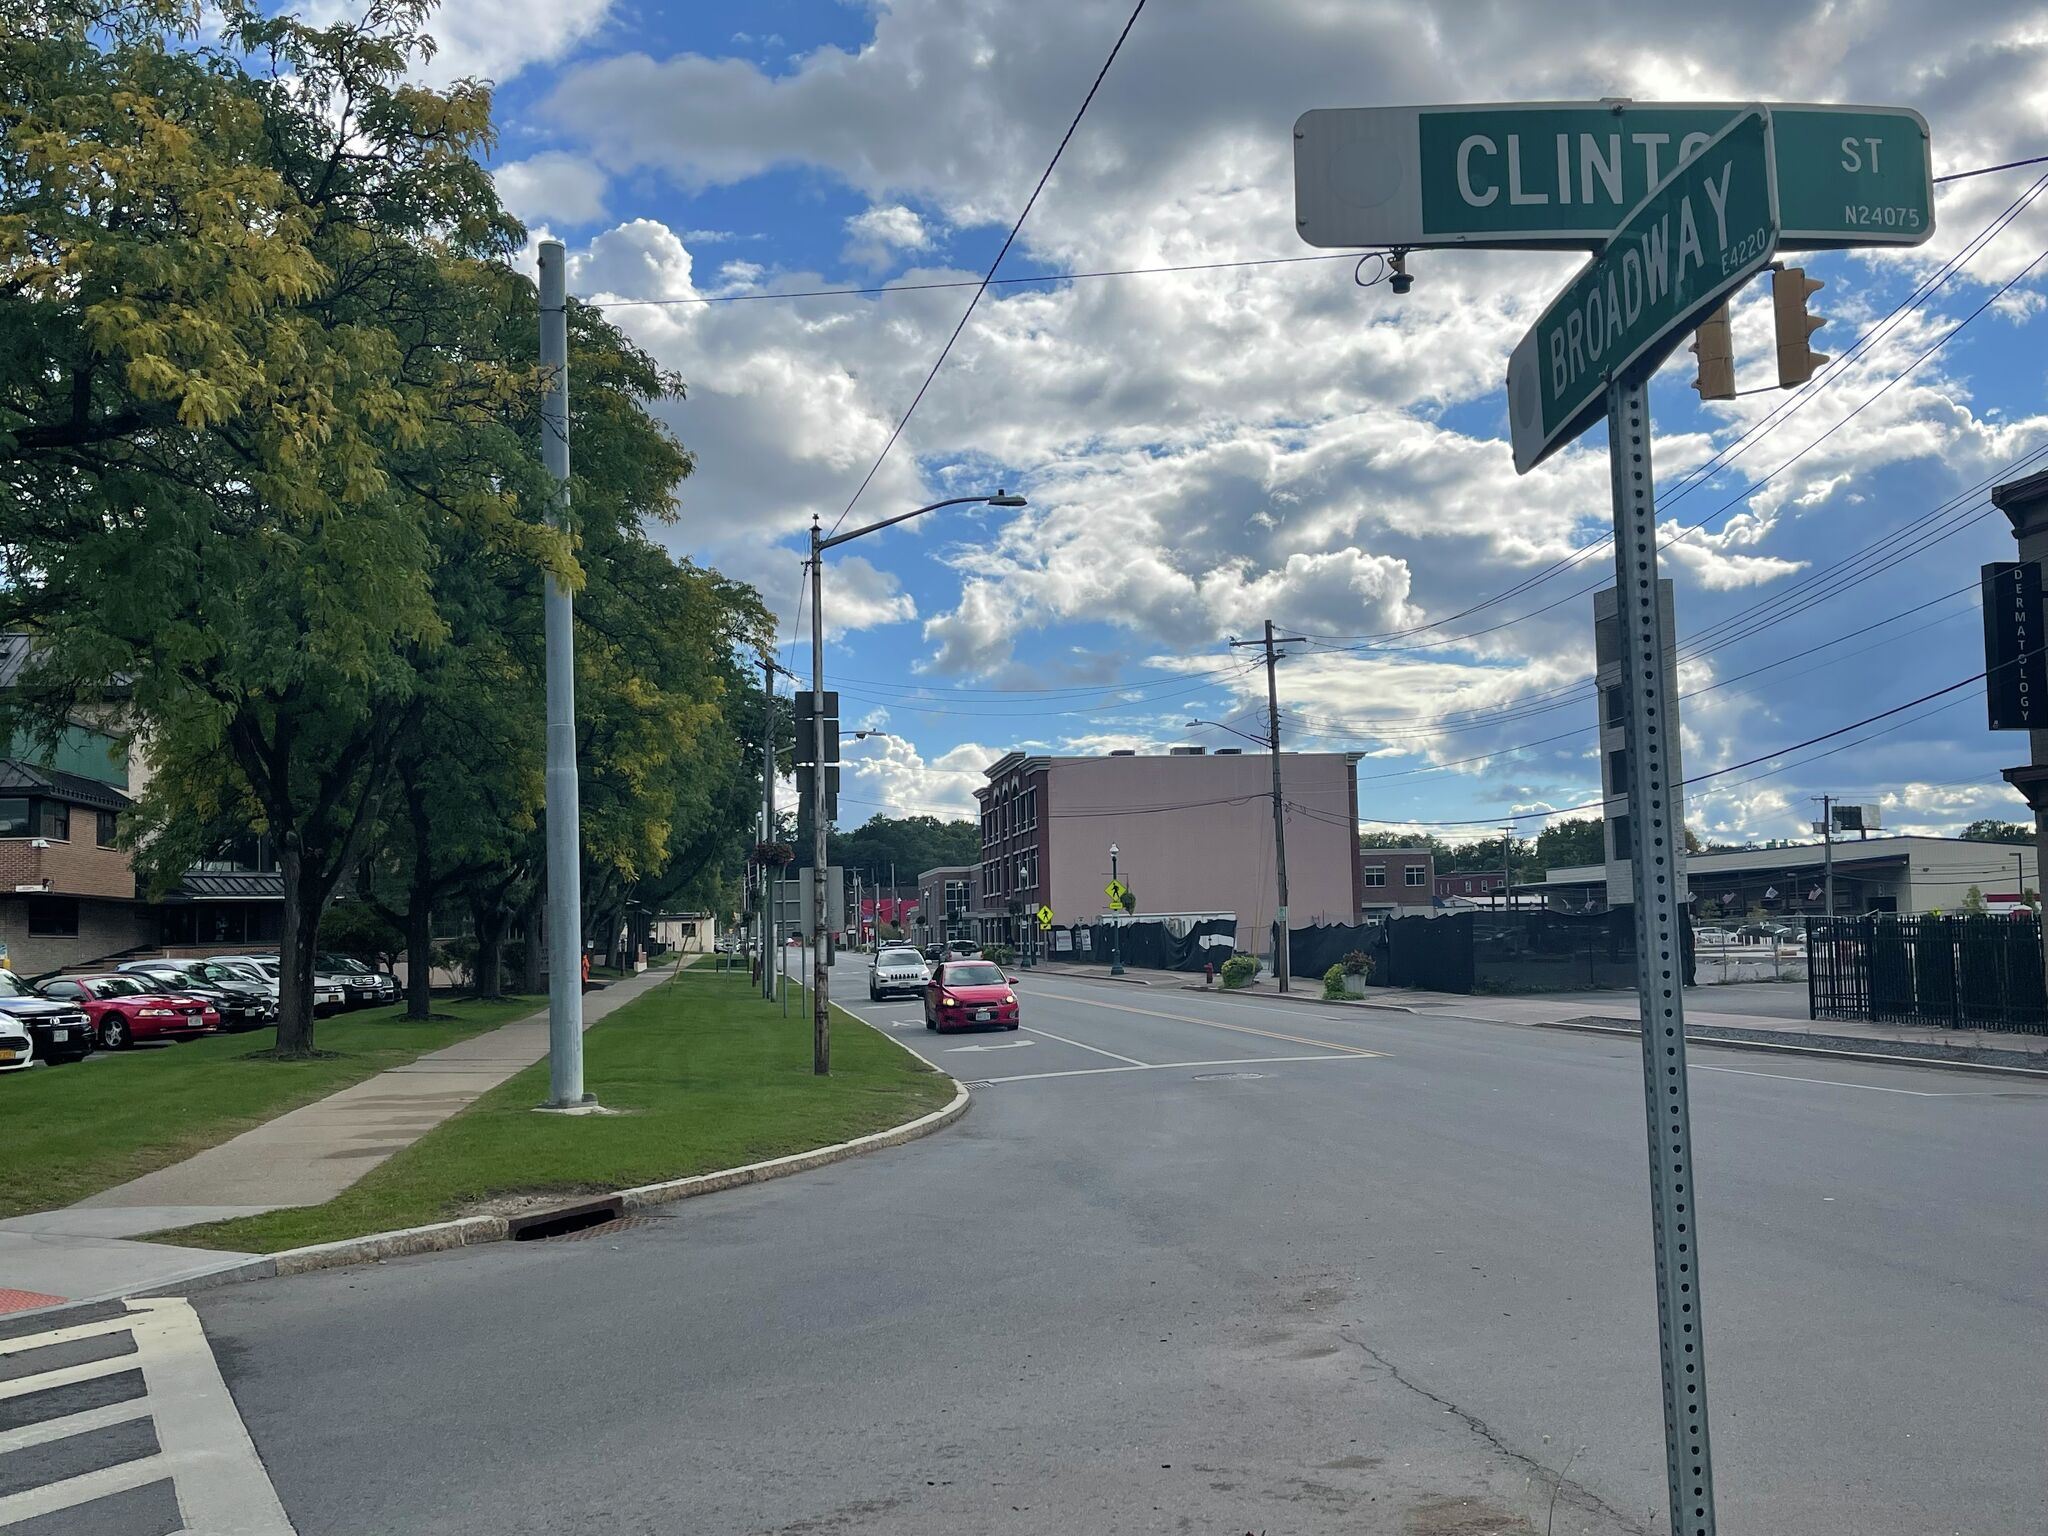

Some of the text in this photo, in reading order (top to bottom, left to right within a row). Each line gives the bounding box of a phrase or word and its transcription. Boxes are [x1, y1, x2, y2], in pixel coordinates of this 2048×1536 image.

[1841, 136, 1883, 173] ST
[1845, 205, 1920, 227] N24075
[1721, 227, 1765, 276] E4220
[1550, 159, 1733, 400] BROADWAY
[2014, 569, 2029, 721] DERMATOLOGY
